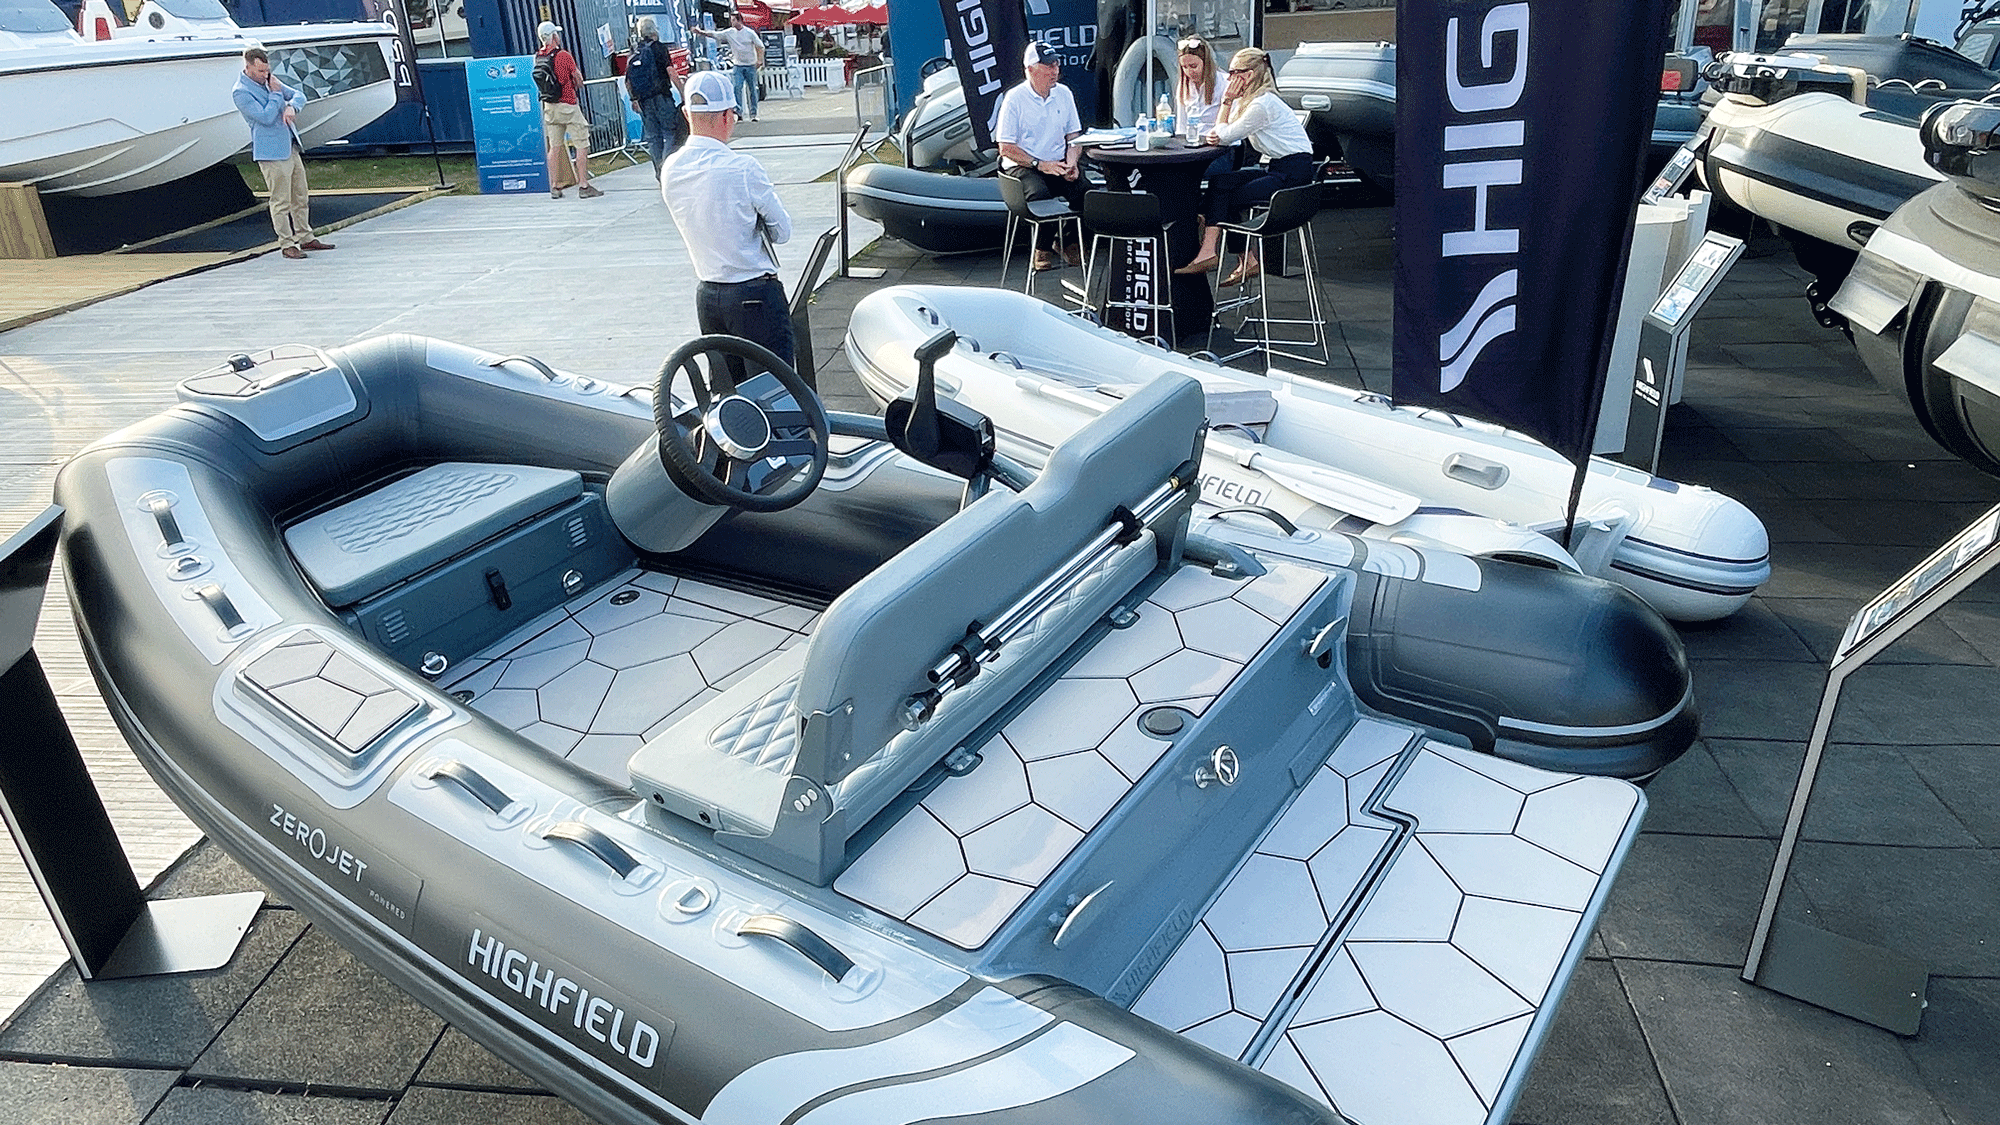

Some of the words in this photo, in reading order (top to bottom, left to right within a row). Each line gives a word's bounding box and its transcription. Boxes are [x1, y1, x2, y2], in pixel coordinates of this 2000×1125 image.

[1028, 24, 1098, 49] IELD
[269, 803, 368, 882] ZEROJET
[369, 889, 406, 920] POWERED
[468, 928, 660, 1069] HIGHFIELD
